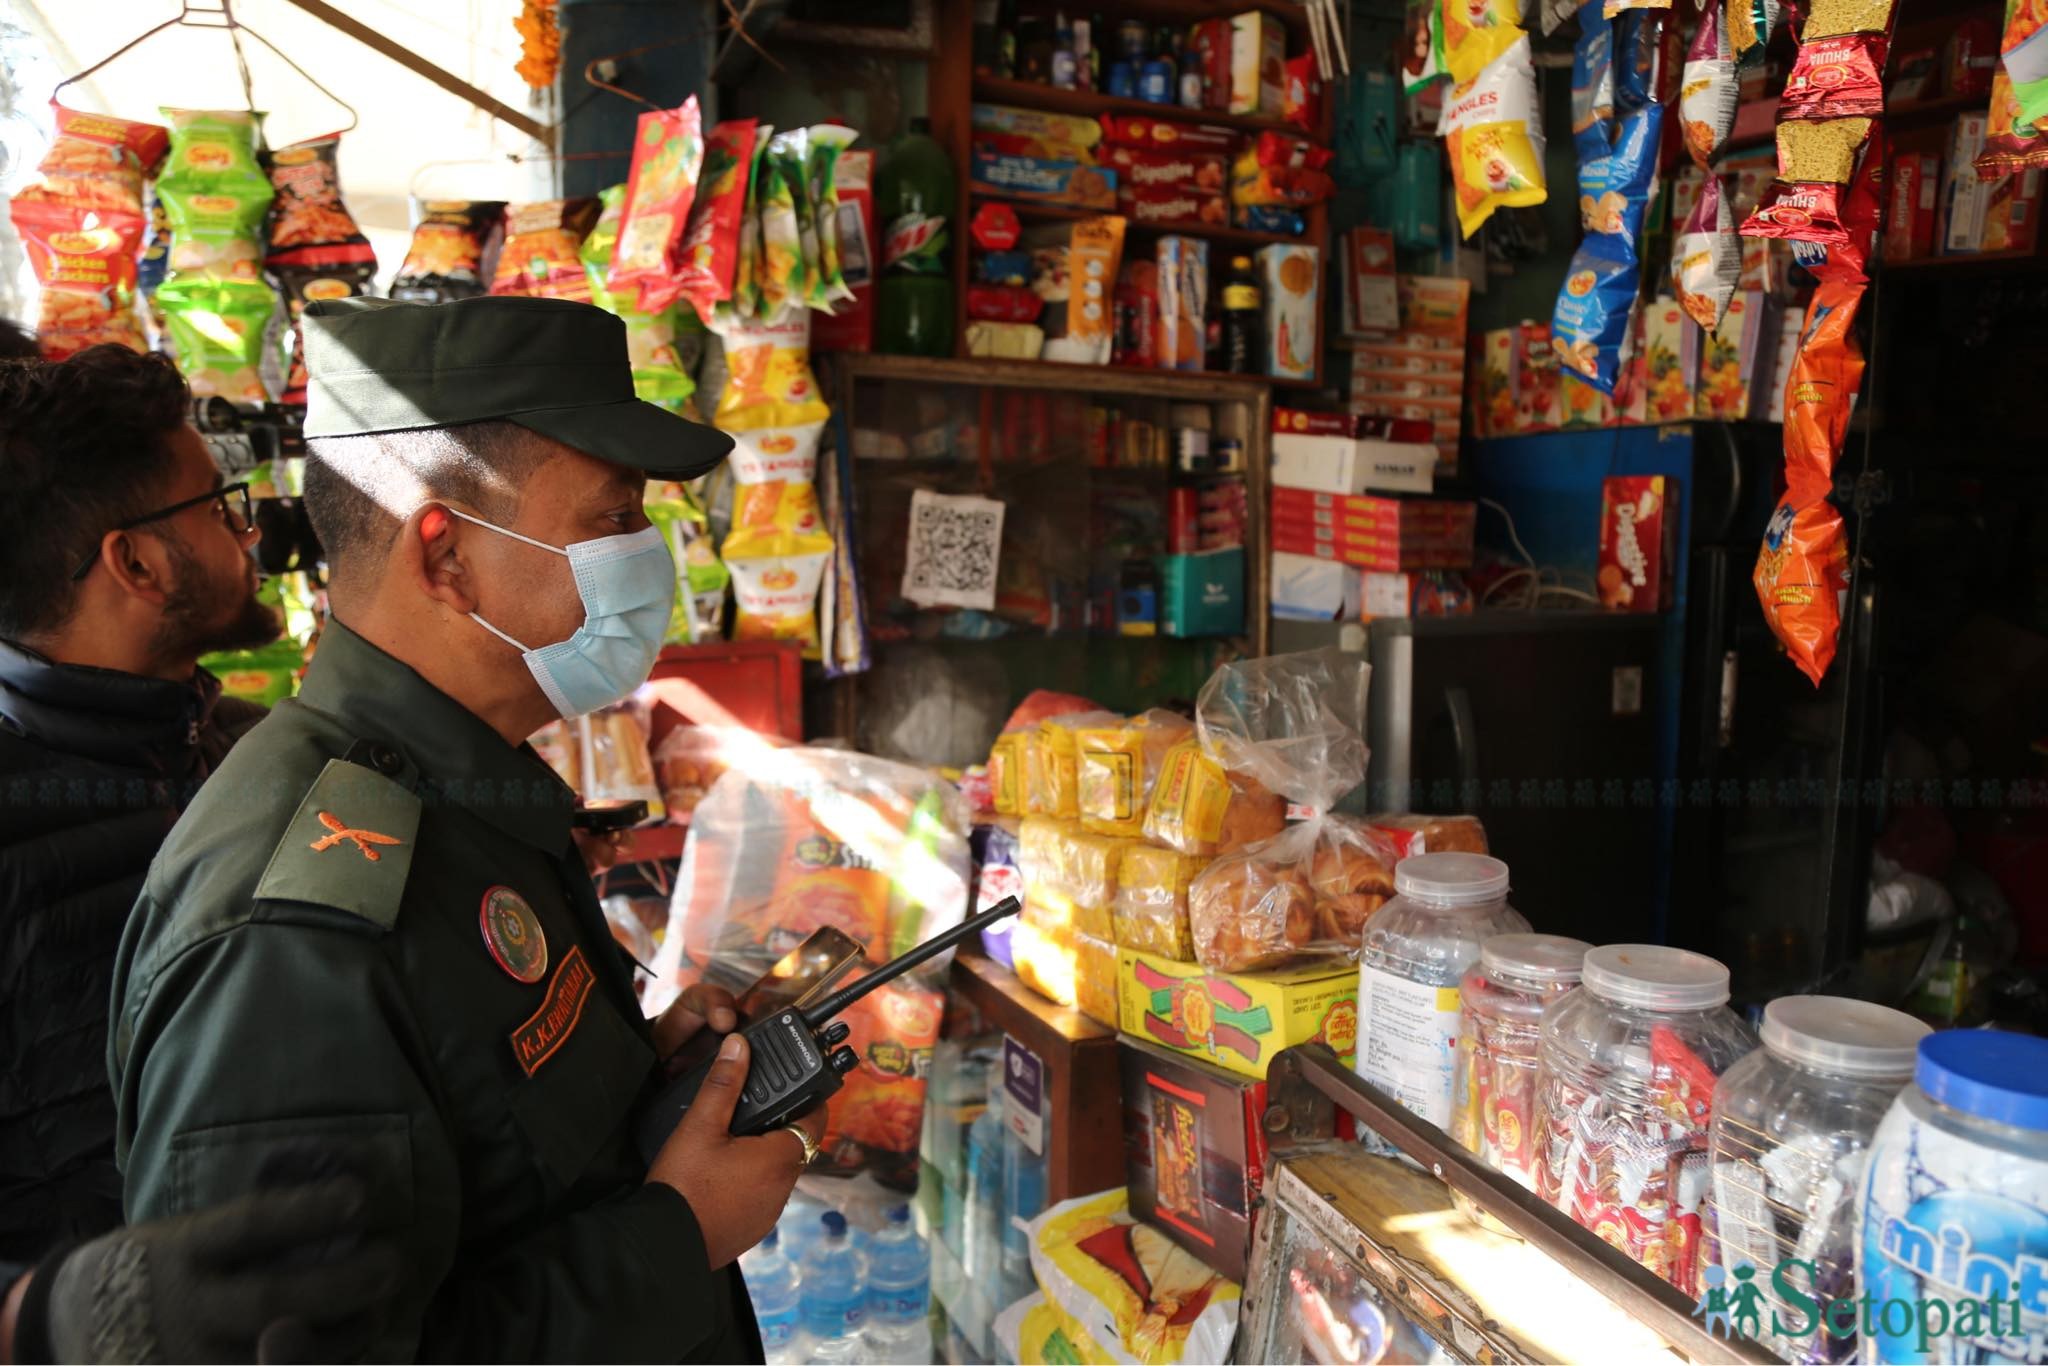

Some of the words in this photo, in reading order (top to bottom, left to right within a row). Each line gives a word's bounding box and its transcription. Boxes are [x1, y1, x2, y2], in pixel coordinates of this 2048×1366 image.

[1132, 162, 1194, 185] Digestive
[1136, 197, 1198, 220] Digestive
[788, 1025, 816, 1068] MOTOROLA
